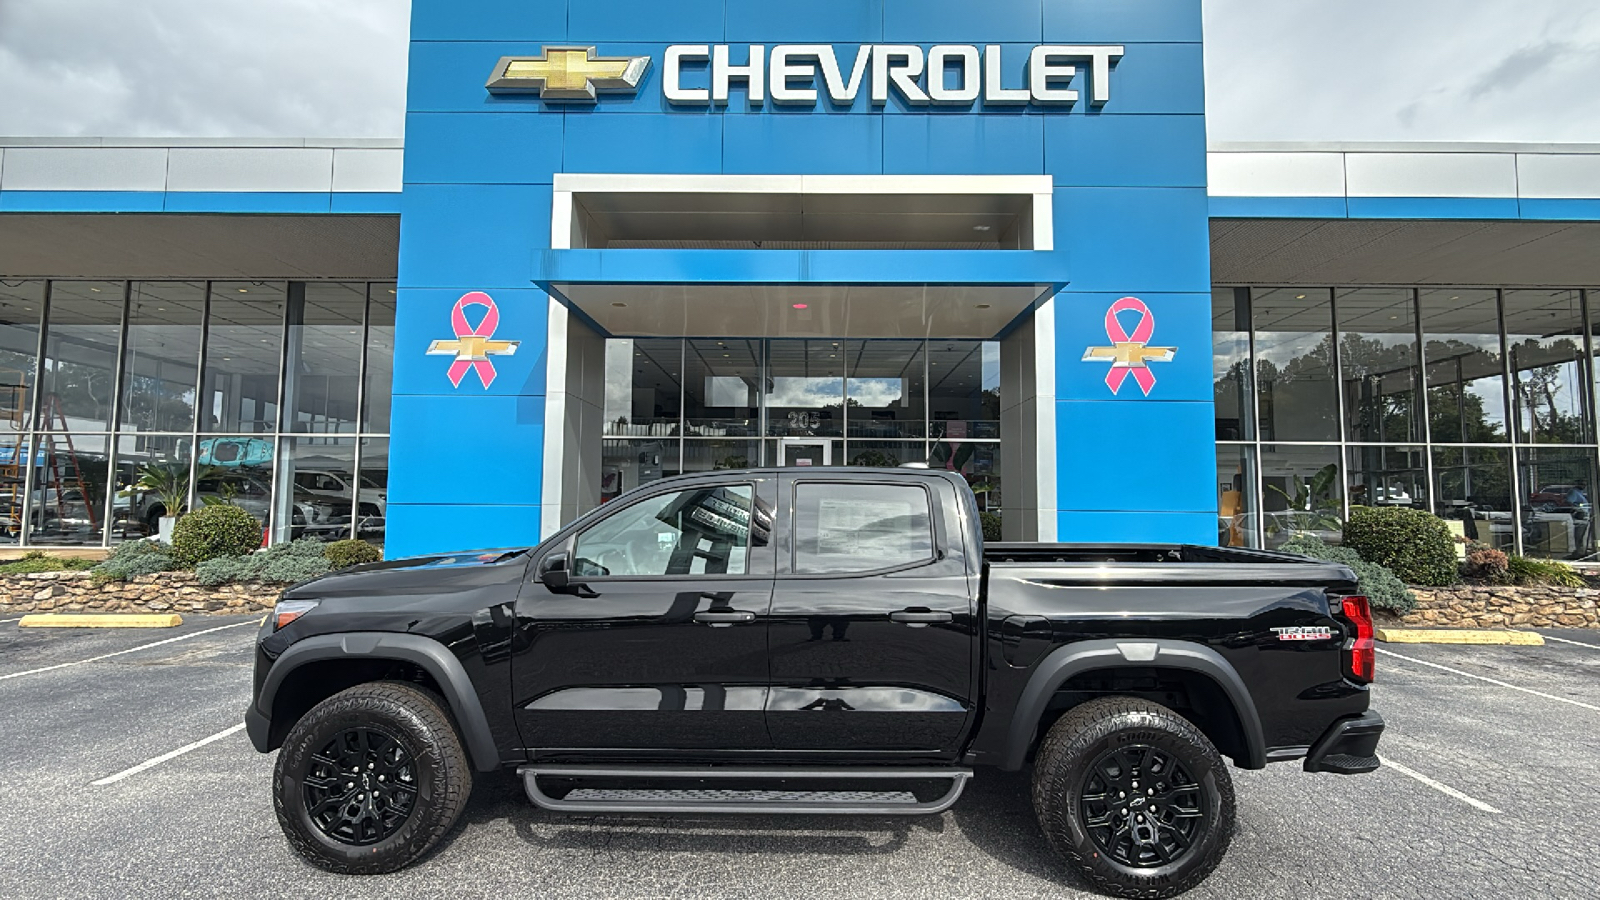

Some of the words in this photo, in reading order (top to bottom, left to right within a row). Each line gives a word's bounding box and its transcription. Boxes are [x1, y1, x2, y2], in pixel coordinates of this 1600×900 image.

[662, 44, 1125, 106] CHEVROLET
[788, 411, 821, 429] 205
[1270, 626, 1339, 635] TRAIL
